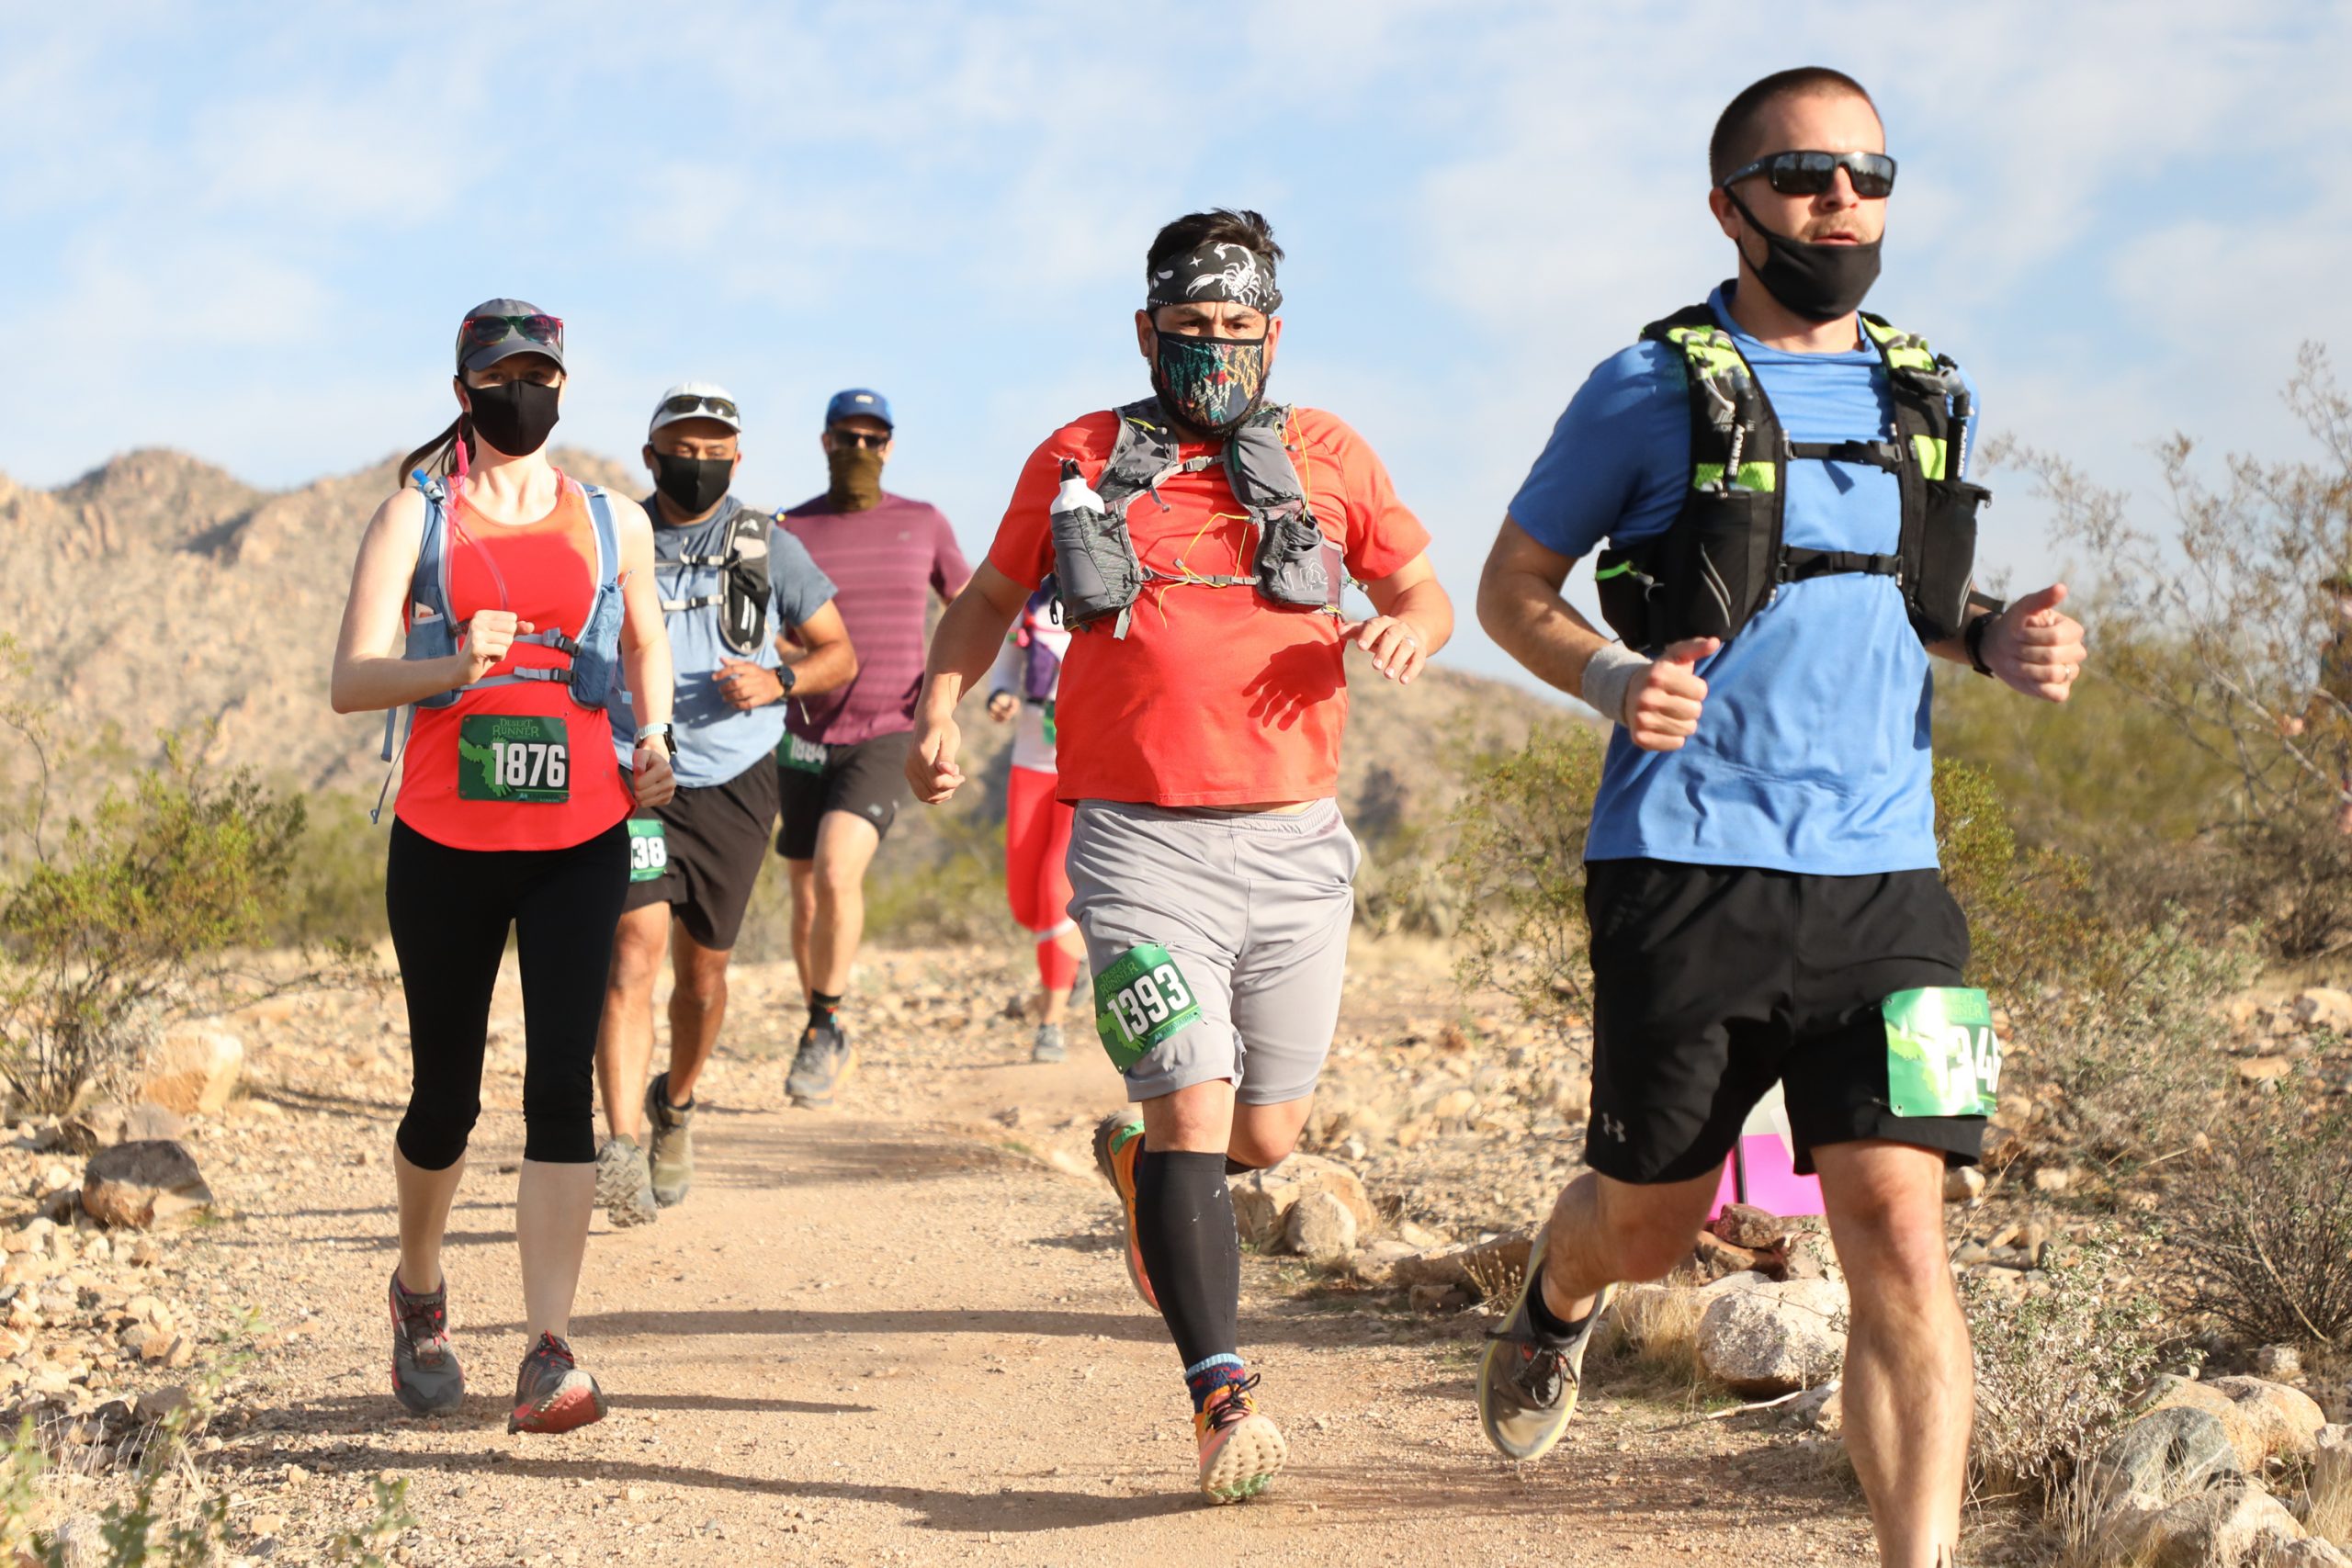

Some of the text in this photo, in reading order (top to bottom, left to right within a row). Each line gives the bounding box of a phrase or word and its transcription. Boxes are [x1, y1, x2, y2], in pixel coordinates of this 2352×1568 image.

[492, 725, 539, 737] RUNNER
[499, 717, 533, 728] DESERT
[492, 742, 566, 787] 1876
[630, 836, 667, 870] 38
[1099, 962, 1139, 997] RUNNER
[1106, 964, 1191, 1043] 1393
